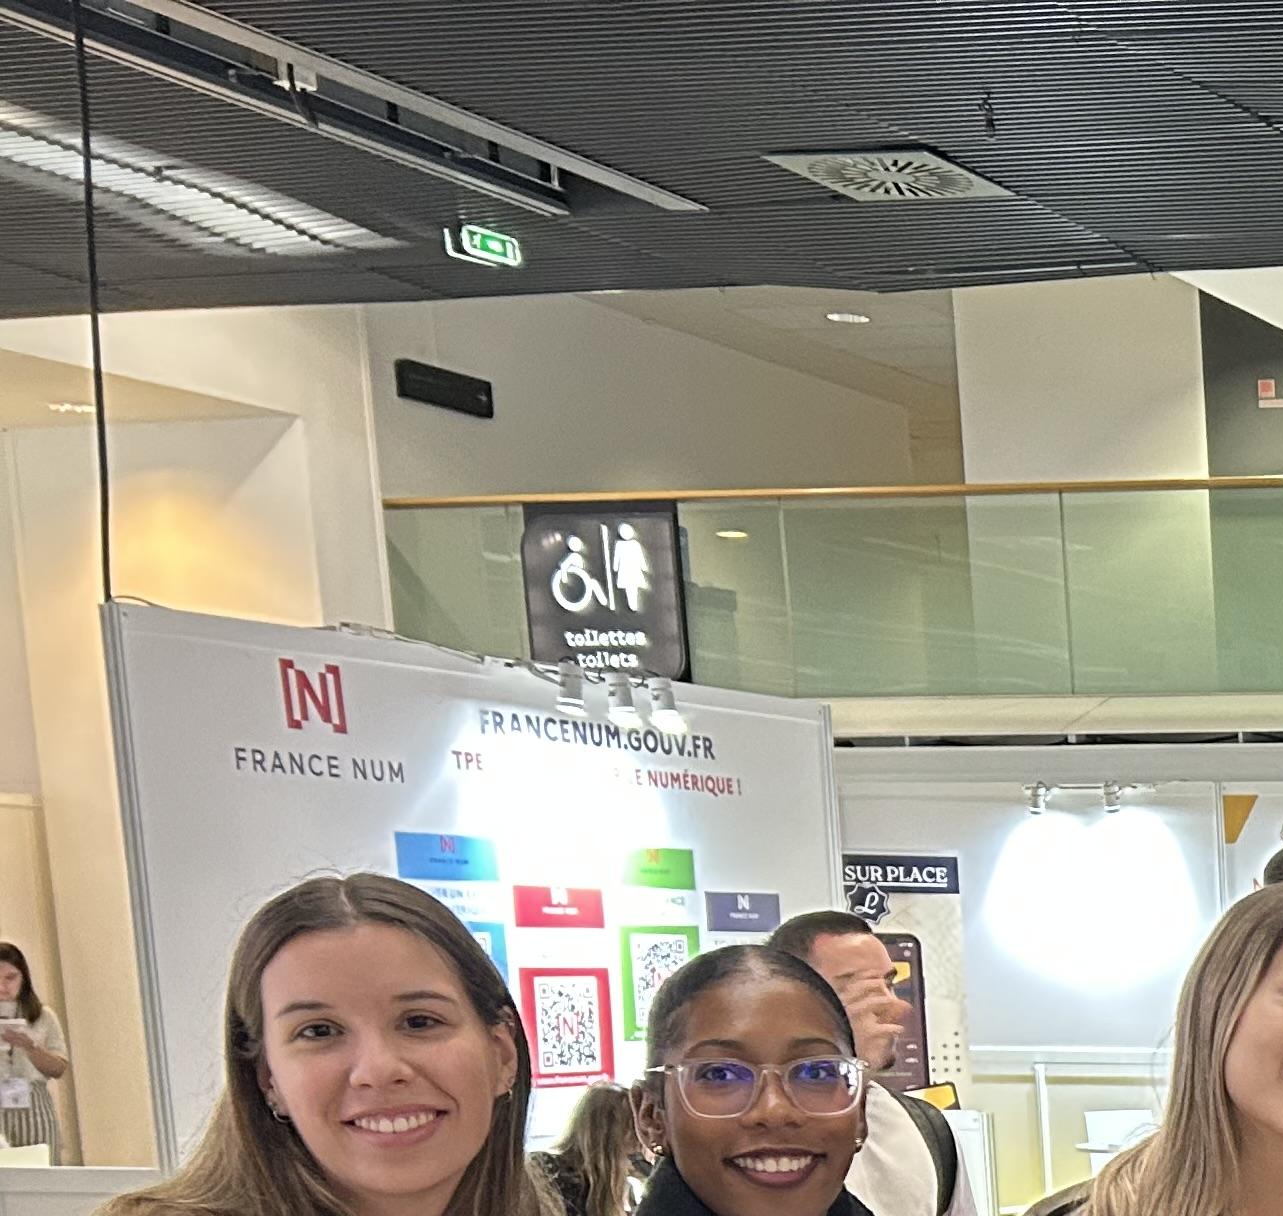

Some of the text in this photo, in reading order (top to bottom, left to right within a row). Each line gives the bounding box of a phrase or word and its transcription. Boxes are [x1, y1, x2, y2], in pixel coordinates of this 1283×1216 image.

[564, 628, 648, 648] toilettes
[577, 652, 639, 668] toilets
[479, 709, 716, 761] FRANCENUM.GOUV.FR
[234, 747, 405, 783] FRANCE NUM
[647, 769, 734, 797] NUMÉRIQUE
[844, 865, 948, 882] SUR PLACE
